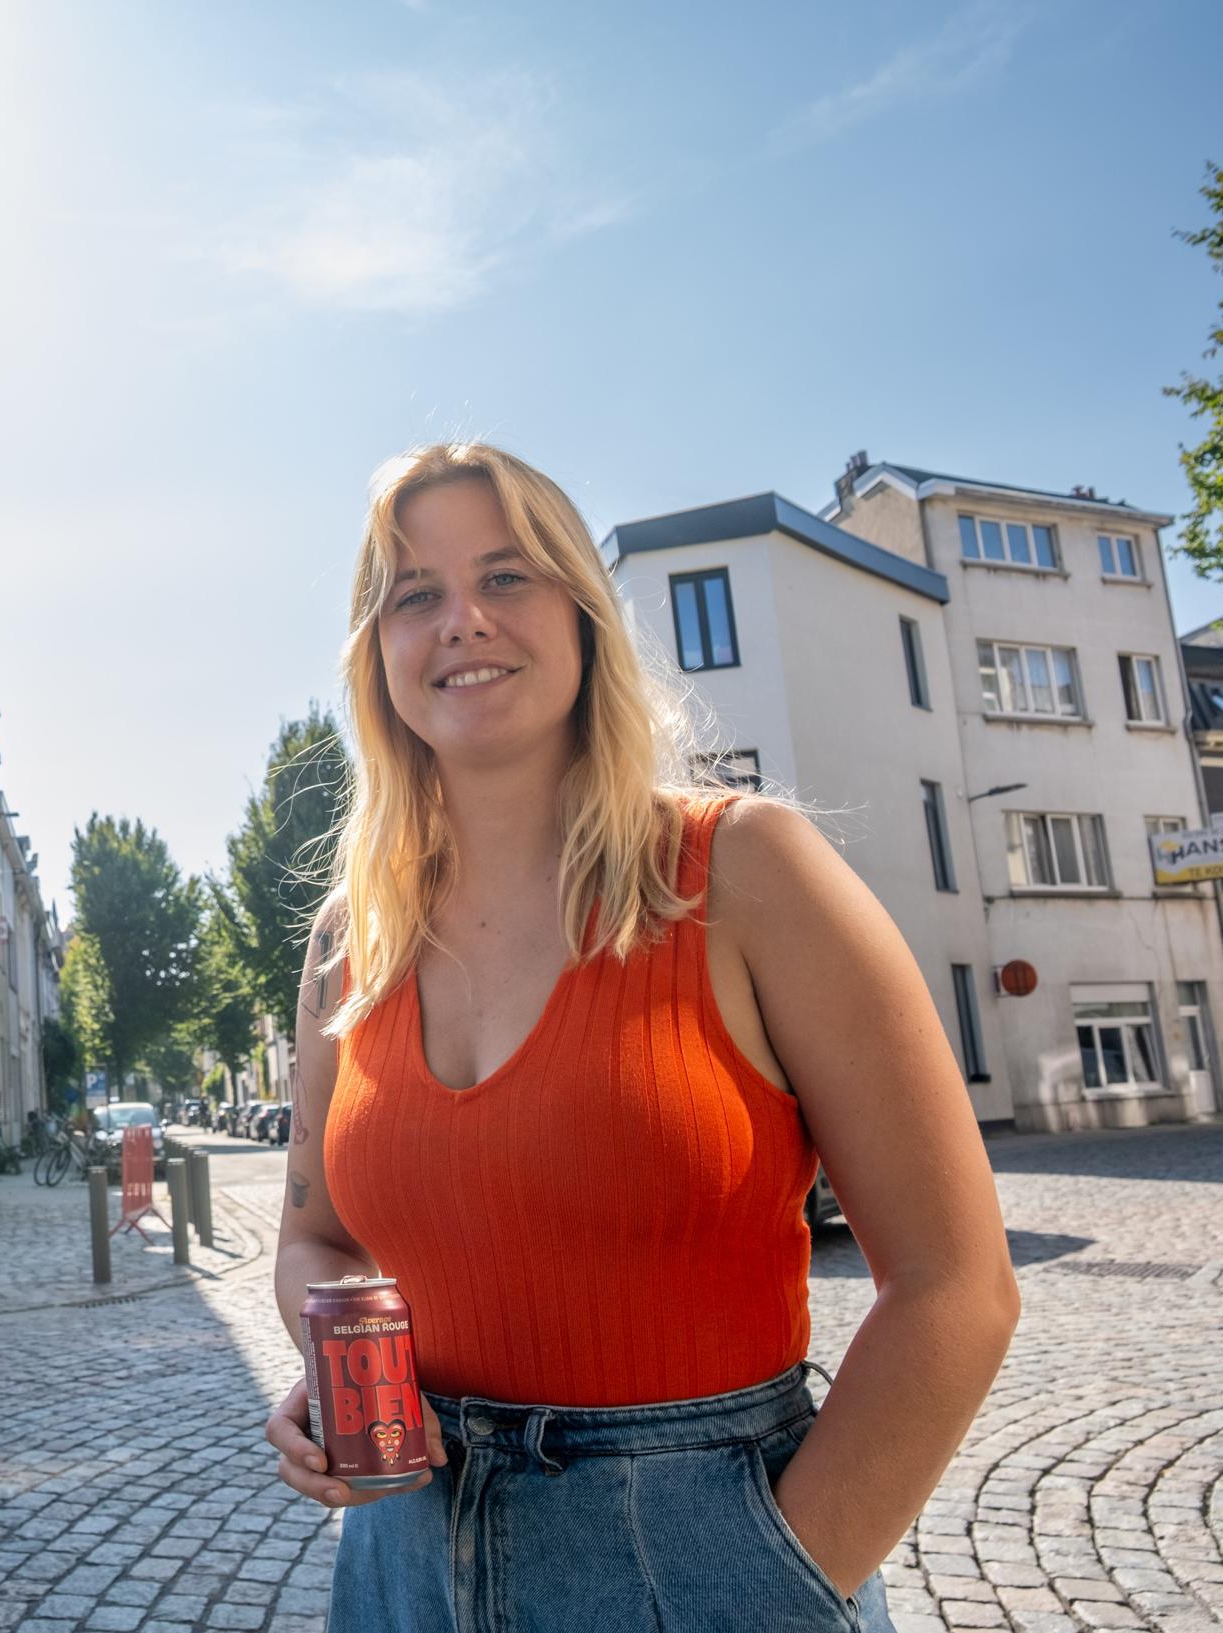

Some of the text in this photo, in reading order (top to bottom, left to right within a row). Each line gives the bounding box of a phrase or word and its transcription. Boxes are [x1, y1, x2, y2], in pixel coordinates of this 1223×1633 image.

[1171, 838, 1223, 865] HAN
[333, 1320, 409, 1335] BELGIAN ROUGE
[332, 1383, 424, 1436] BIEN
